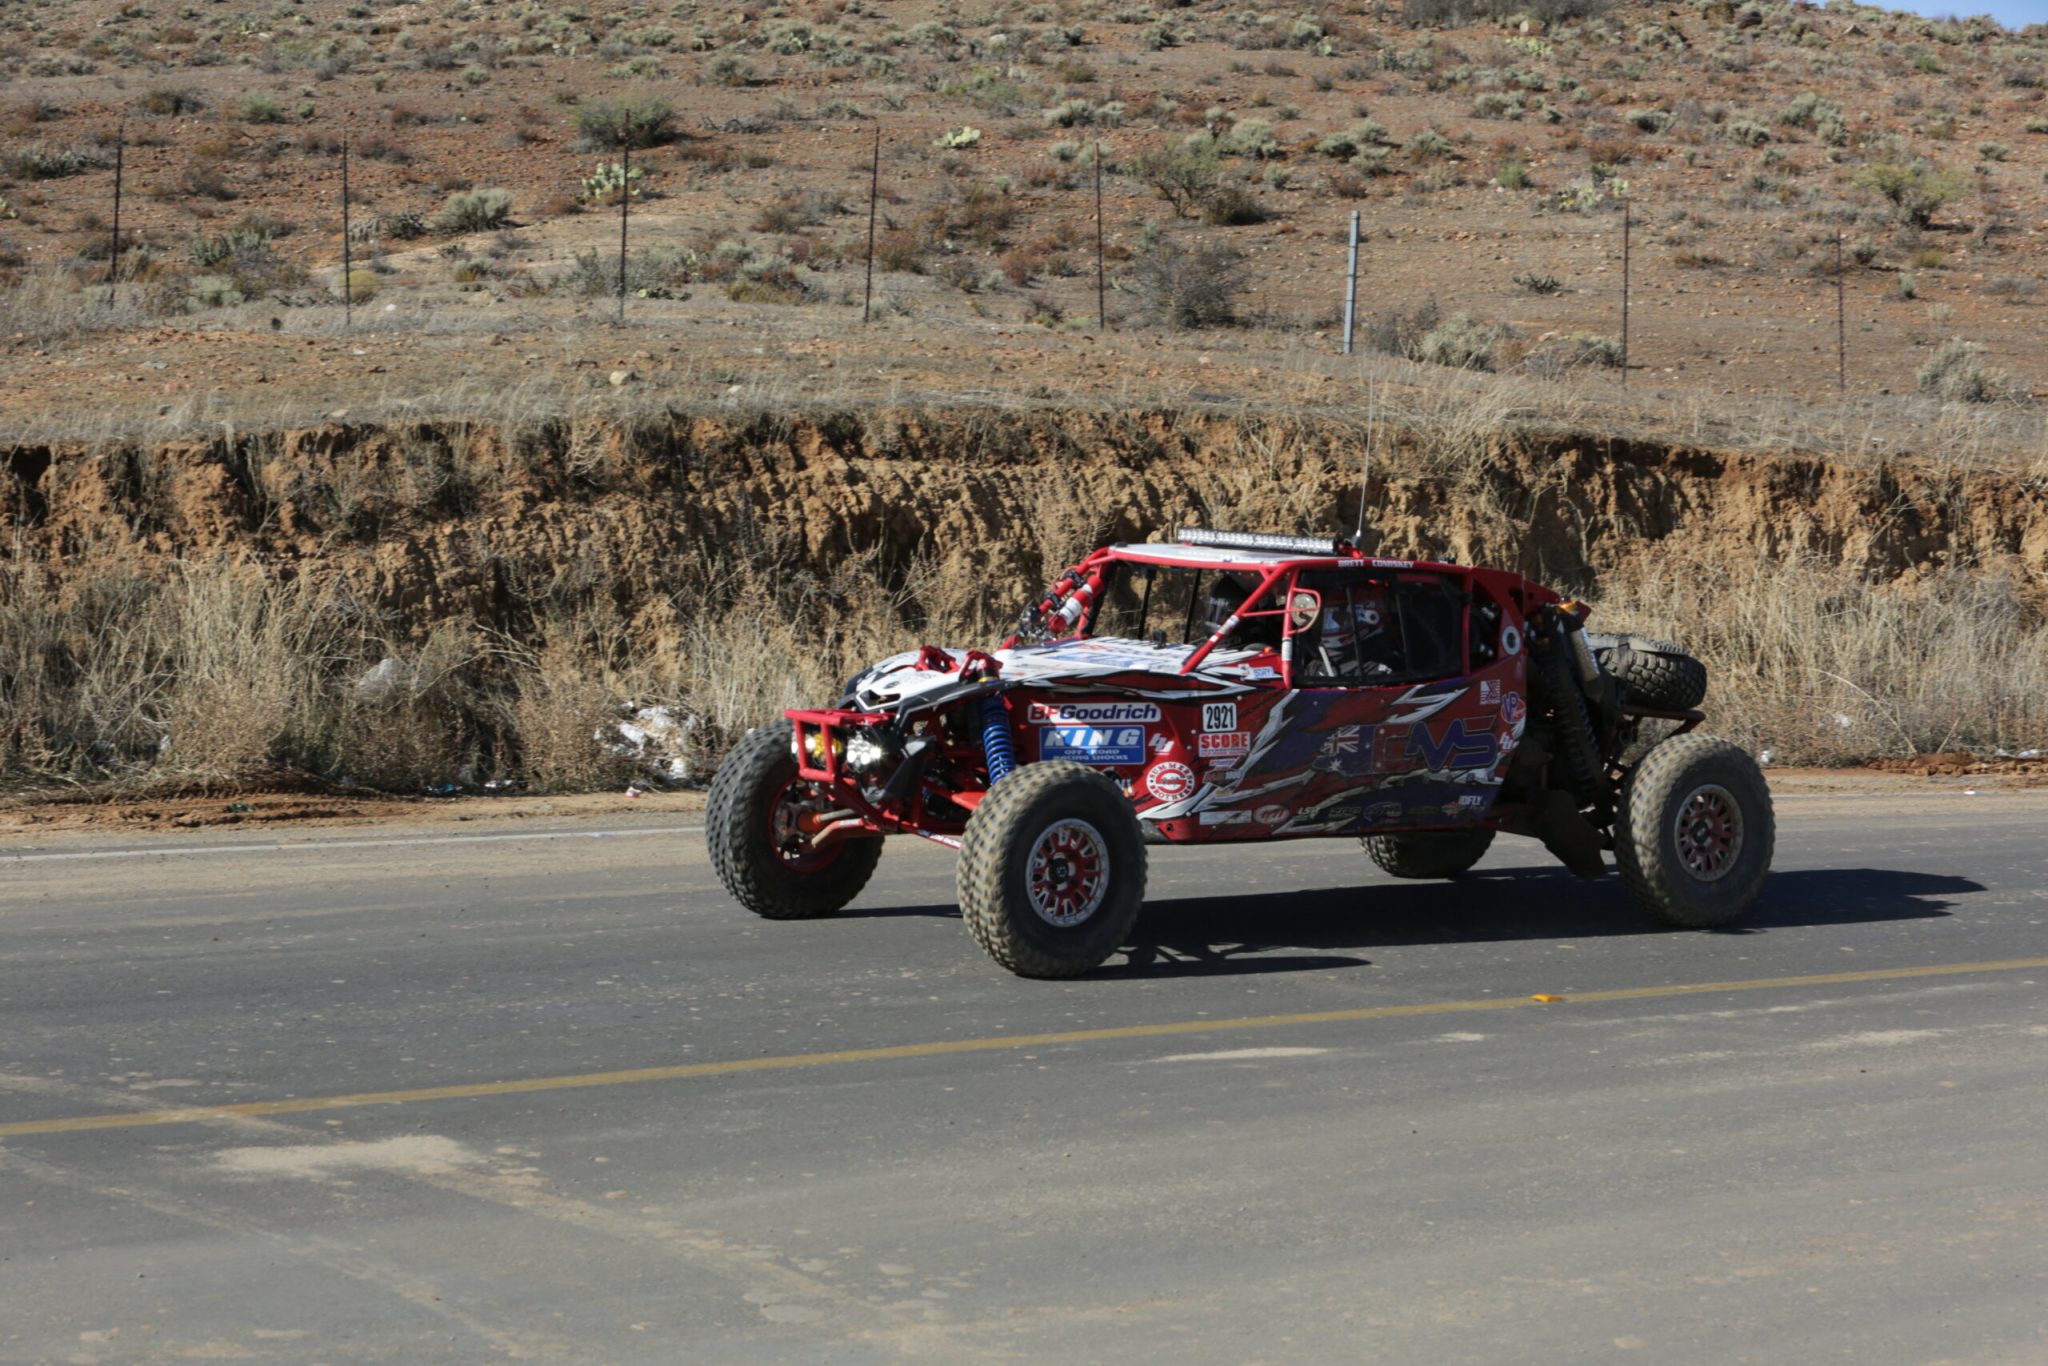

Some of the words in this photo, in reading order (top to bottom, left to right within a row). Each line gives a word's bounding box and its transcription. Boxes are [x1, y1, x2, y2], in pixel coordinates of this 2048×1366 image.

[1030, 704, 1157, 720] BFGoodrich
[1207, 705, 1234, 729] 2921
[1044, 729, 1141, 746] KING
[1201, 735, 1248, 749] SCORE
